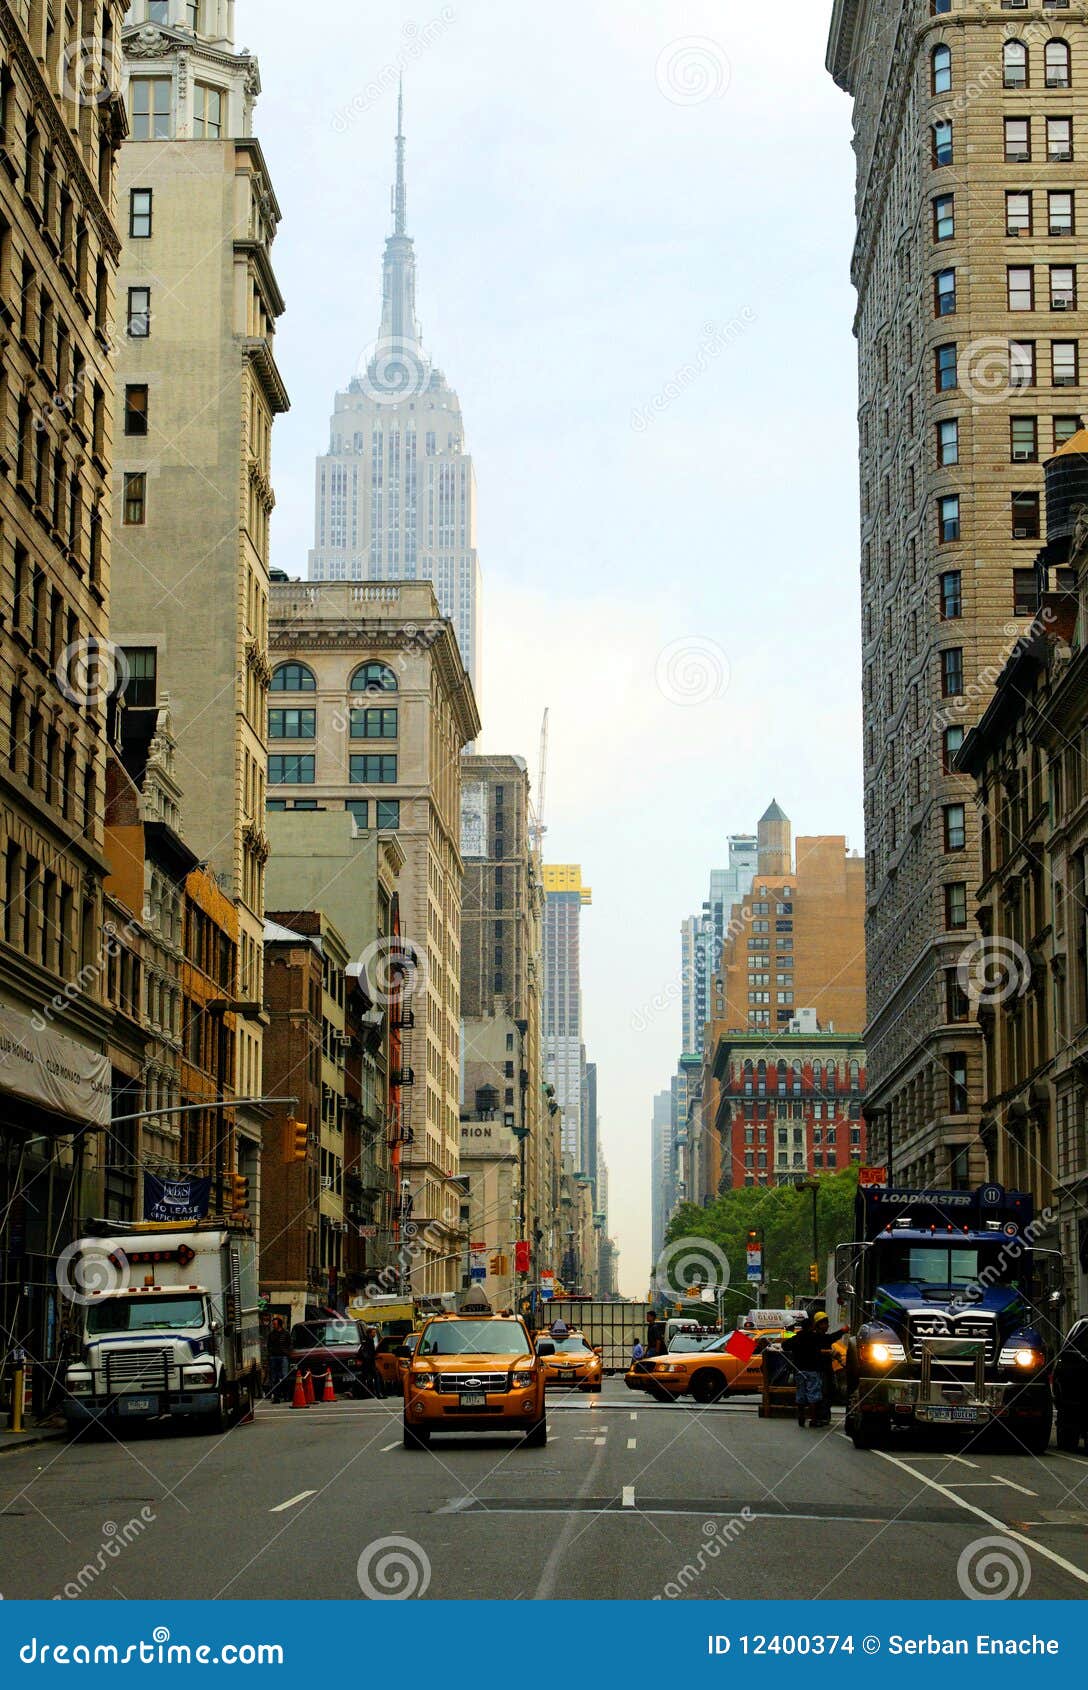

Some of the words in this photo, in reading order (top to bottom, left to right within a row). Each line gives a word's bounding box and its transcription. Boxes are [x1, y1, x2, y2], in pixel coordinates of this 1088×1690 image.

[881, 1193, 972, 1206] LOADMASTER
[987, 1190, 997, 1201] 11
[154, 1203, 167, 1213] TO
[170, 1205, 200, 1215] LEASE
[916, 1326, 990, 1337] MACK
